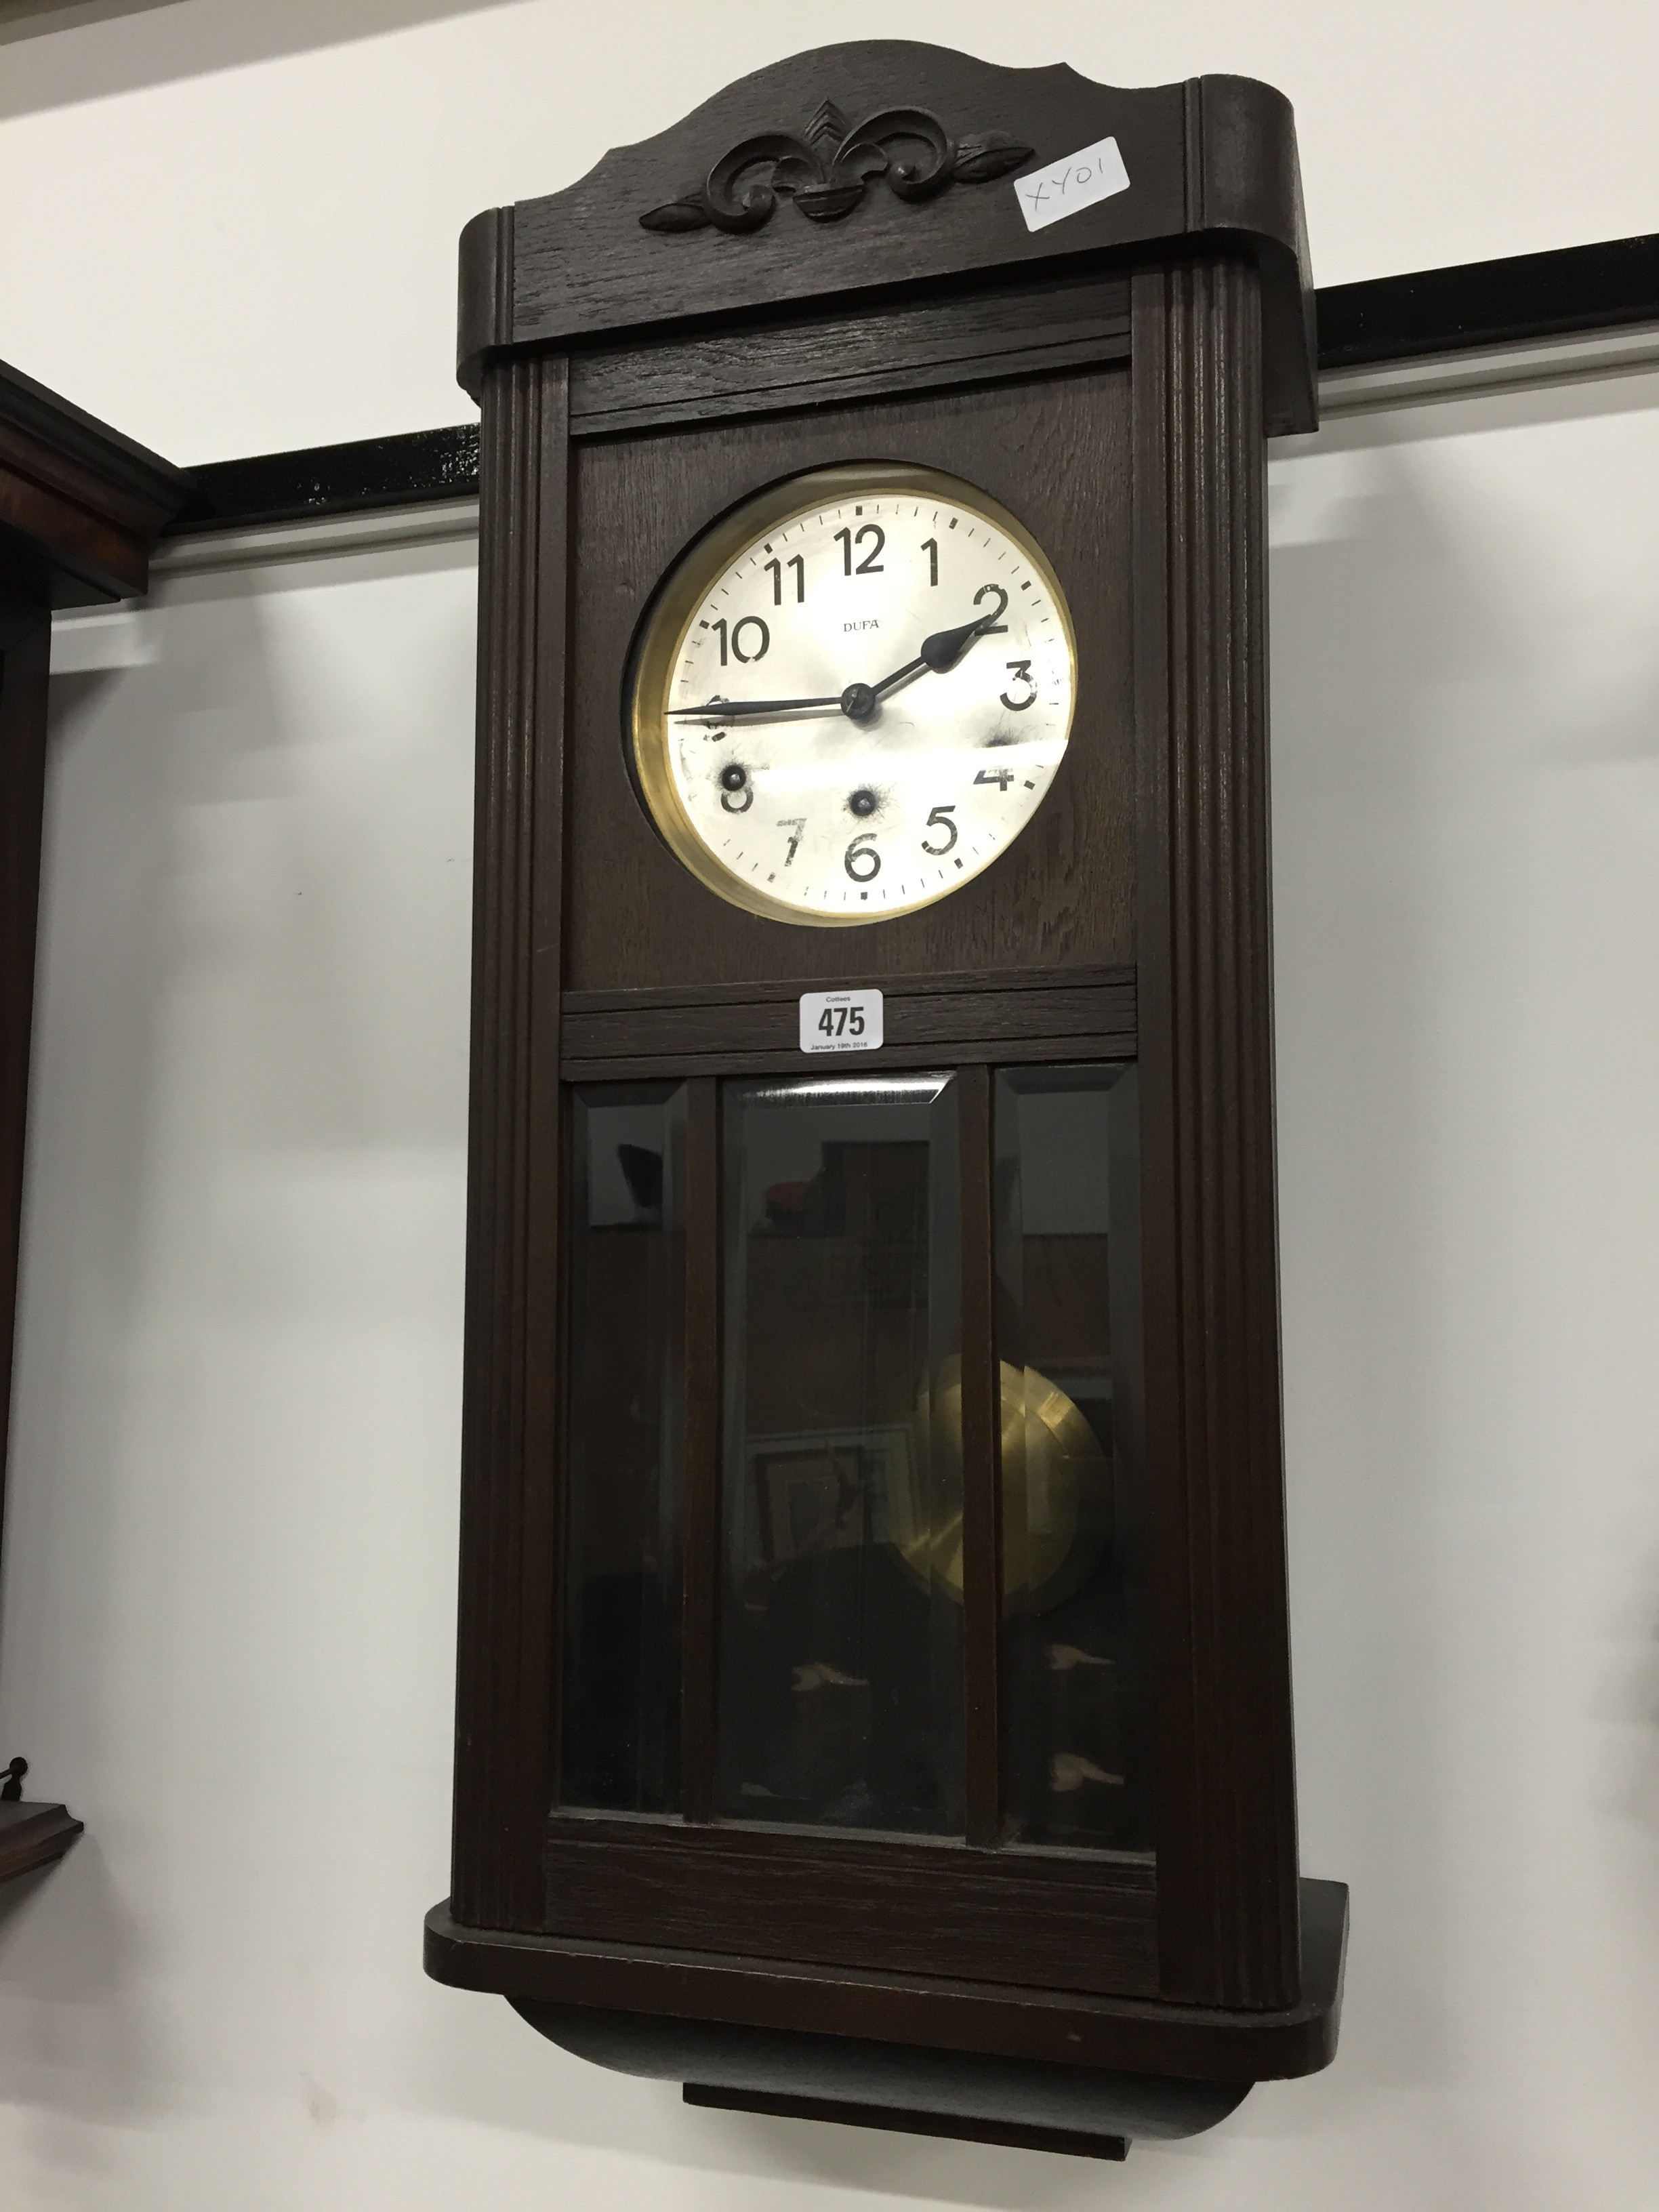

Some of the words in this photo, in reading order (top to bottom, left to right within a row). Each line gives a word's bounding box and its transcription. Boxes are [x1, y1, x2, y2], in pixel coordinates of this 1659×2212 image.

[834, 524, 885, 576] 12
[920, 537, 939, 587] 1
[764, 554, 804, 605] 11
[843, 619, 880, 632] DUFA
[973, 583, 1008, 636] 2
[711, 616, 771, 666] 10
[1000, 659, 1038, 712] 3
[777, 817, 807, 867] 7
[921, 805, 958, 856] 5
[844, 833, 882, 883] 6
[818, 1006, 865, 1037] 475
